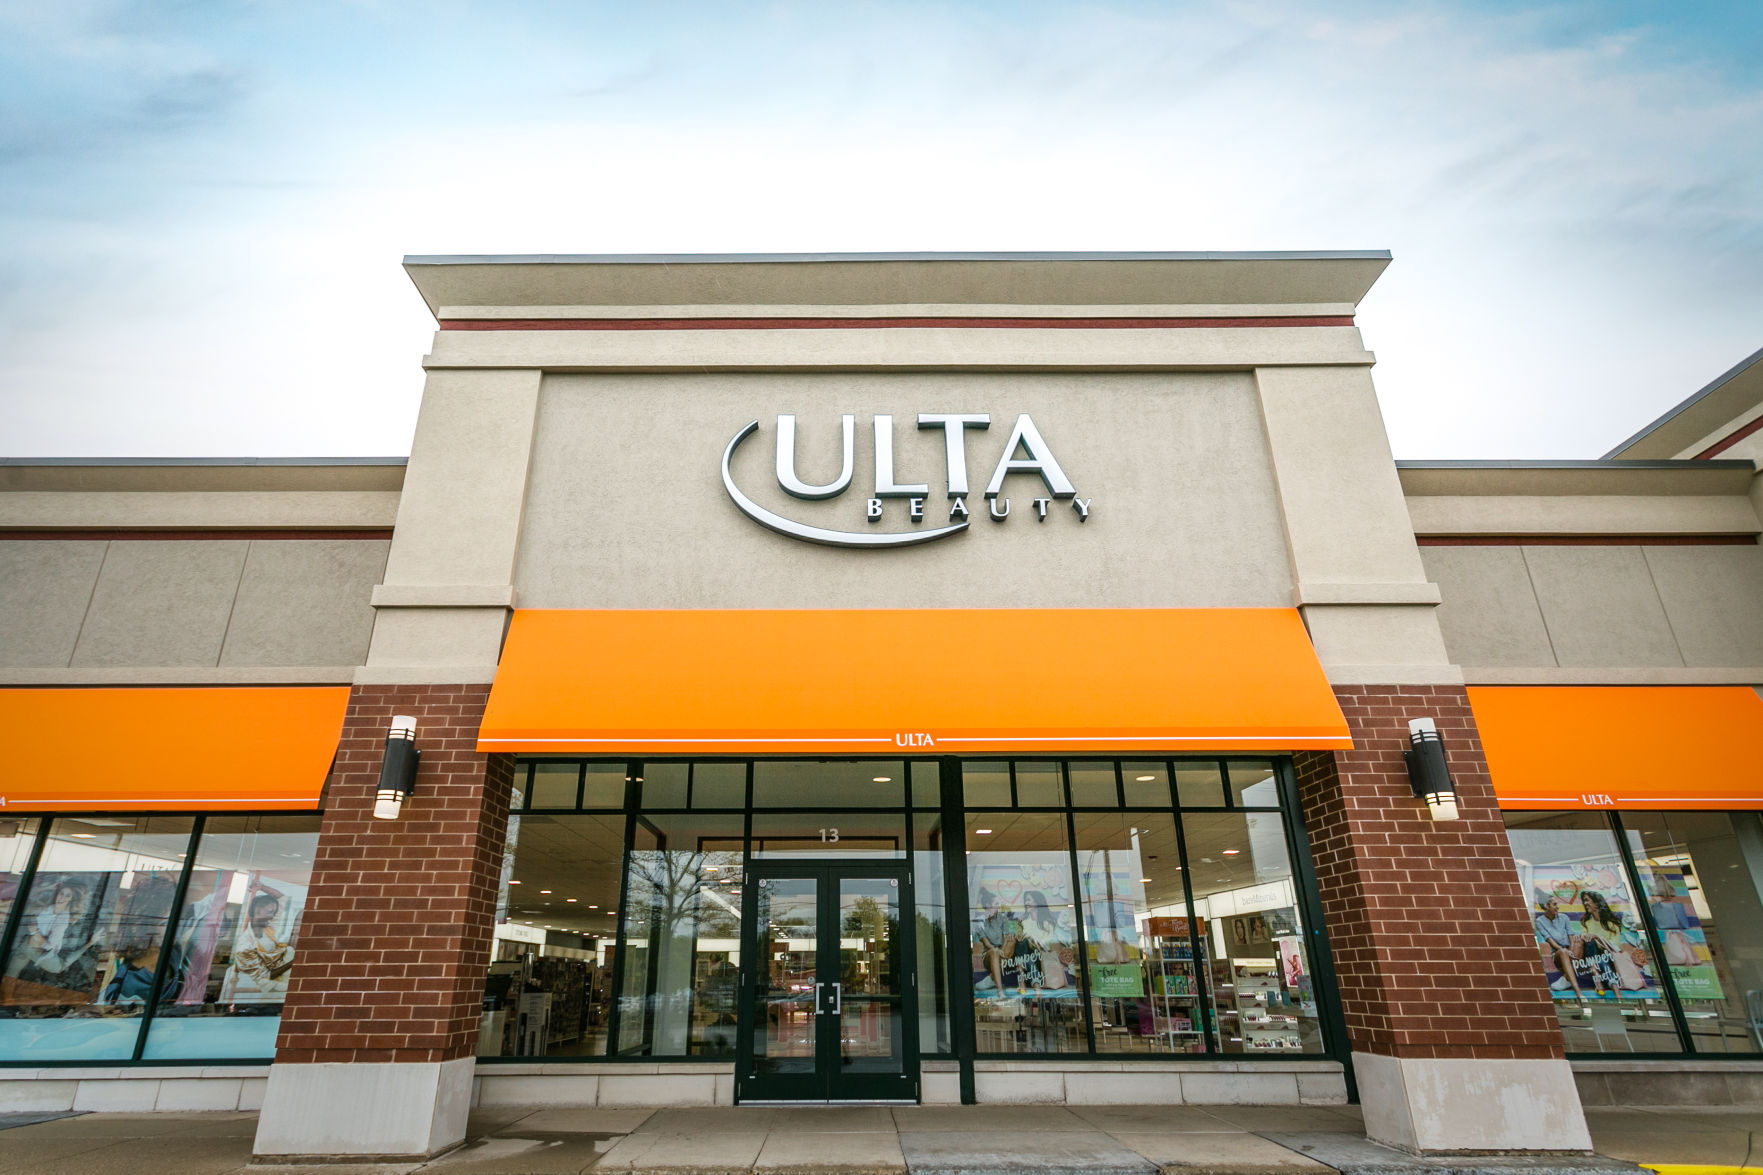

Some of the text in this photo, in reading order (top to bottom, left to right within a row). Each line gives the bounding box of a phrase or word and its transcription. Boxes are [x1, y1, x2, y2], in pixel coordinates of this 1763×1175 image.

[776, 413, 1076, 500] ULTA
[867, 498, 1092, 523] BEAUTY
[895, 733, 935, 747] ULTA
[1581, 794, 1614, 806] ULTA
[819, 828, 840, 843] 13
[1001, 949, 1043, 976] pamper
[1572, 949, 1616, 977] pamper
[1017, 965, 1046, 987] pretty
[1592, 967, 1623, 989] pretty
